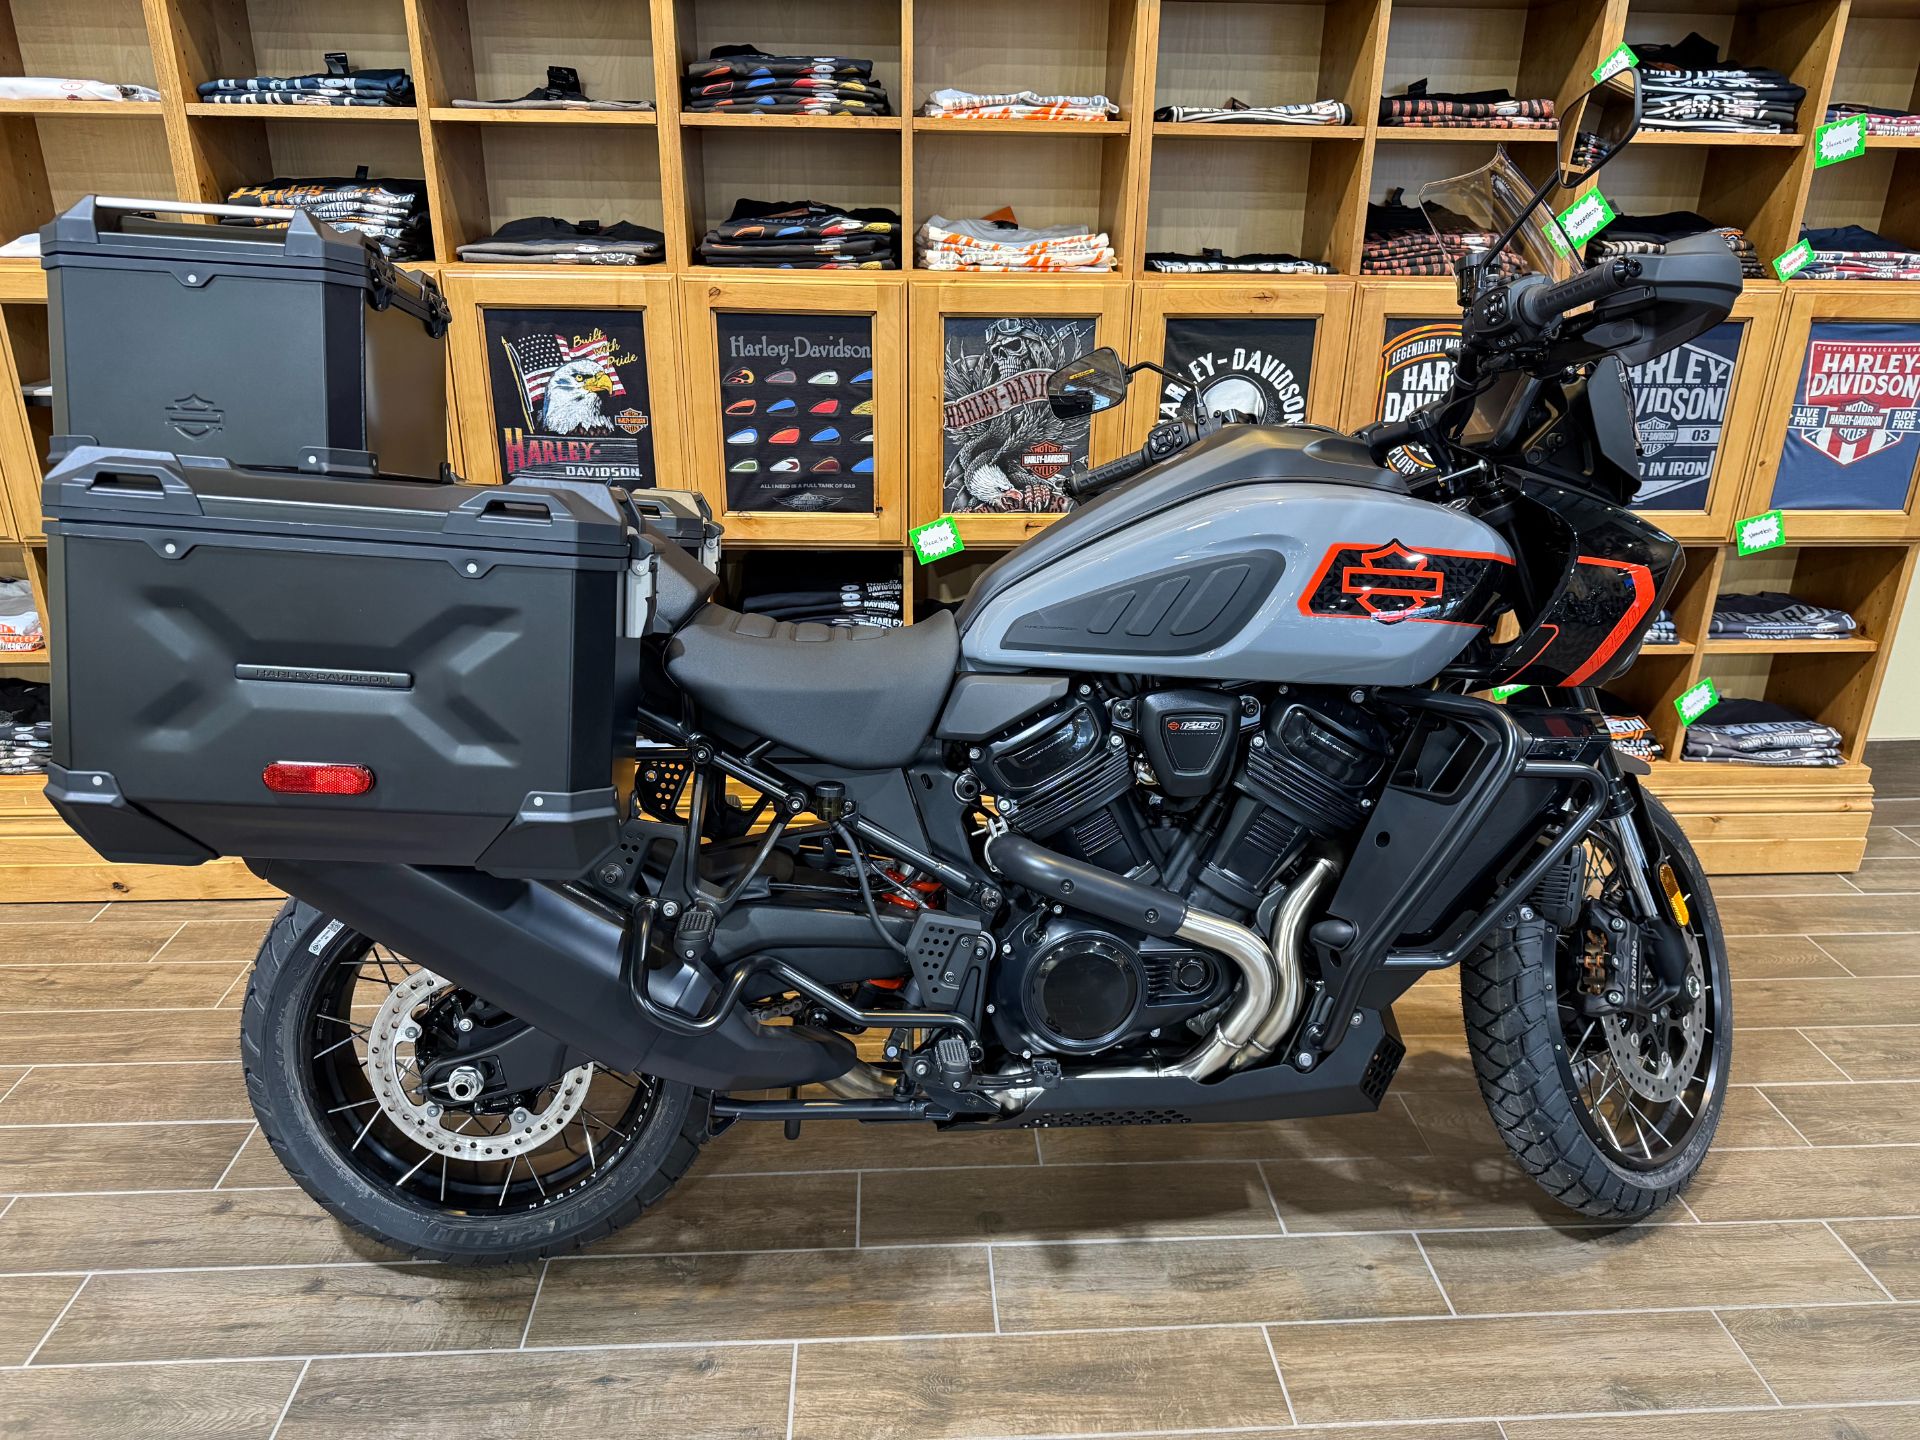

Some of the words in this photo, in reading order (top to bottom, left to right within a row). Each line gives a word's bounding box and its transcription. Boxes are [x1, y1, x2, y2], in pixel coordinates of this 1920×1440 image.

[573, 327, 605, 348] Built
[592, 338, 621, 357] with
[729, 335, 872, 366] Harley-Davidson
[1392, 338, 1443, 366] LEGENDARY
[606, 352, 638, 369] Pride
[1627, 347, 1728, 384] ARLEY-
[1821, 353, 1920, 374] HARLEY-
[1809, 374, 1919, 398] DAVIDSON
[943, 373, 1047, 428] HARLEY-DAVI
[1845, 401, 1874, 413] MOTOR
[1796, 407, 1820, 417] LIVE
[1895, 410, 1917, 420] RIDE
[1793, 417, 1819, 427] FREE
[1829, 414, 1884, 426] HARLEY-DAVIDSON
[1891, 420, 1916, 430] FREE
[1691, 429, 1710, 442] 03
[1838, 428, 1867, 442] CYCLES
[503, 427, 602, 474] HARLEY-
[1023, 455, 1069, 464] HARLEY-DAVIDSON
[1032, 466, 1059, 477] CYCLES
[1649, 462, 1666, 476] IN
[1668, 461, 1707, 476] IRON
[863, 600, 900, 611] DAVIDSON
[1589, 605, 1641, 672] 1250
[256, 669, 392, 685] HARLEY-DAVIDSON
[1180, 721, 1221, 731] 1250
[529, 1075, 656, 1210] HARLEY-DAVIDSON
